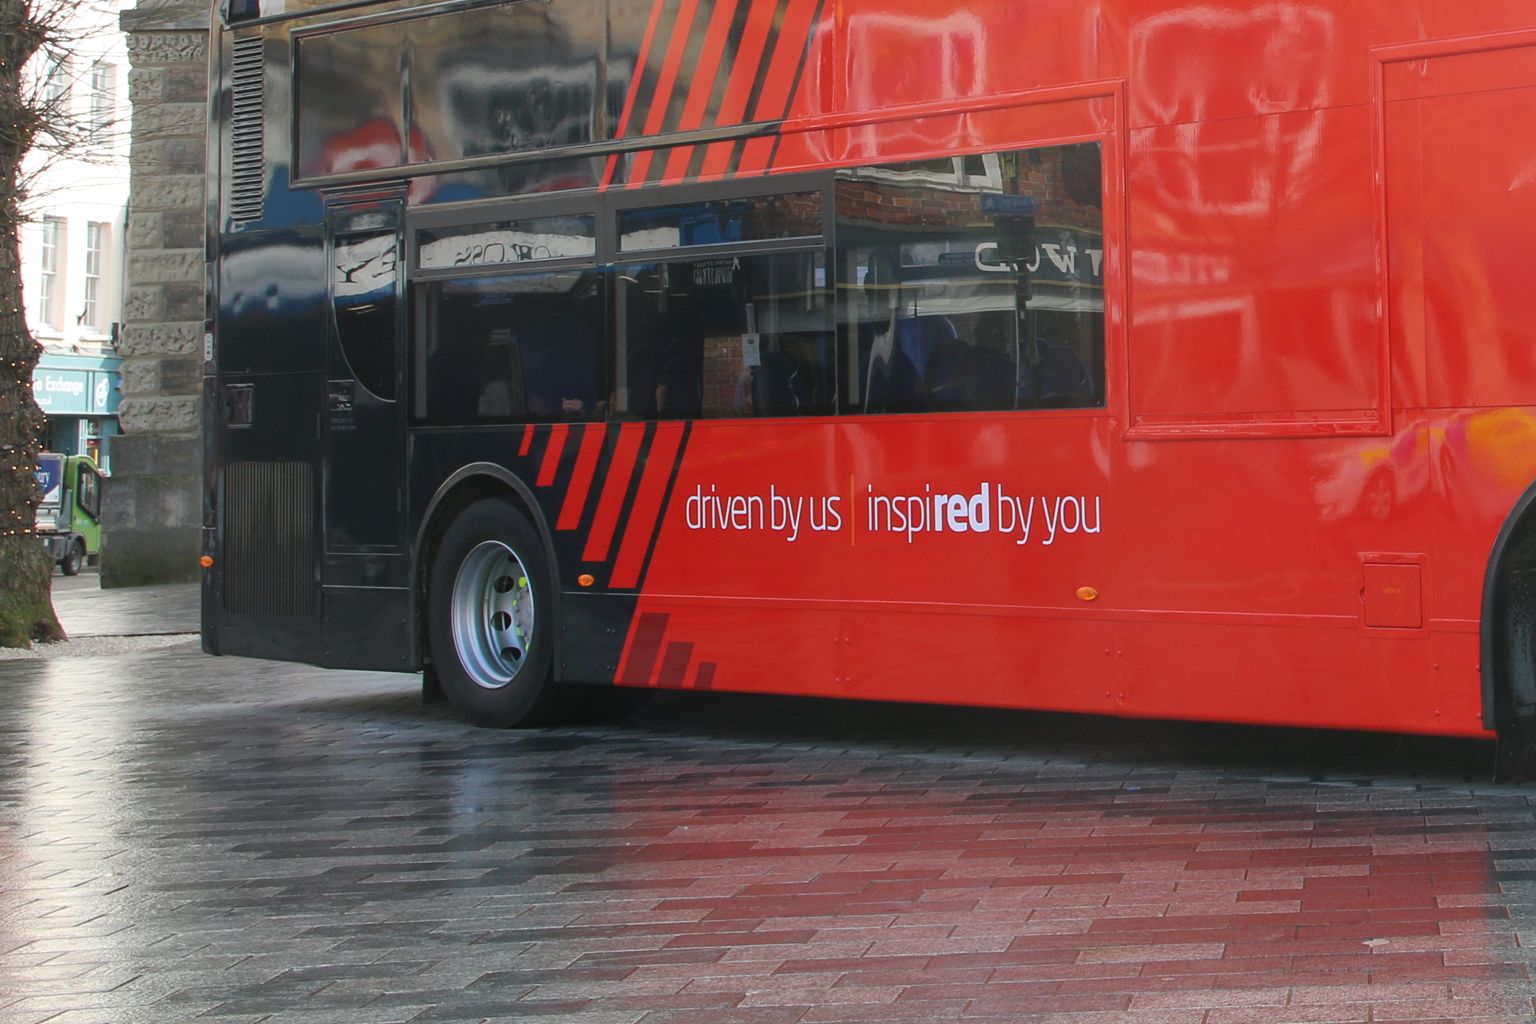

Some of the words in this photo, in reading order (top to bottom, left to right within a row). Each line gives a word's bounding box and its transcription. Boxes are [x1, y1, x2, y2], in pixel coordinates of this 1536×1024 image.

[45, 375, 84, 397] Exchange
[685, 483, 764, 532] driven
[770, 483, 804, 543] by
[810, 494, 842, 532] us
[867, 481, 989, 544] inspired
[997, 482, 1035, 546] by
[1042, 494, 1102, 546] you
